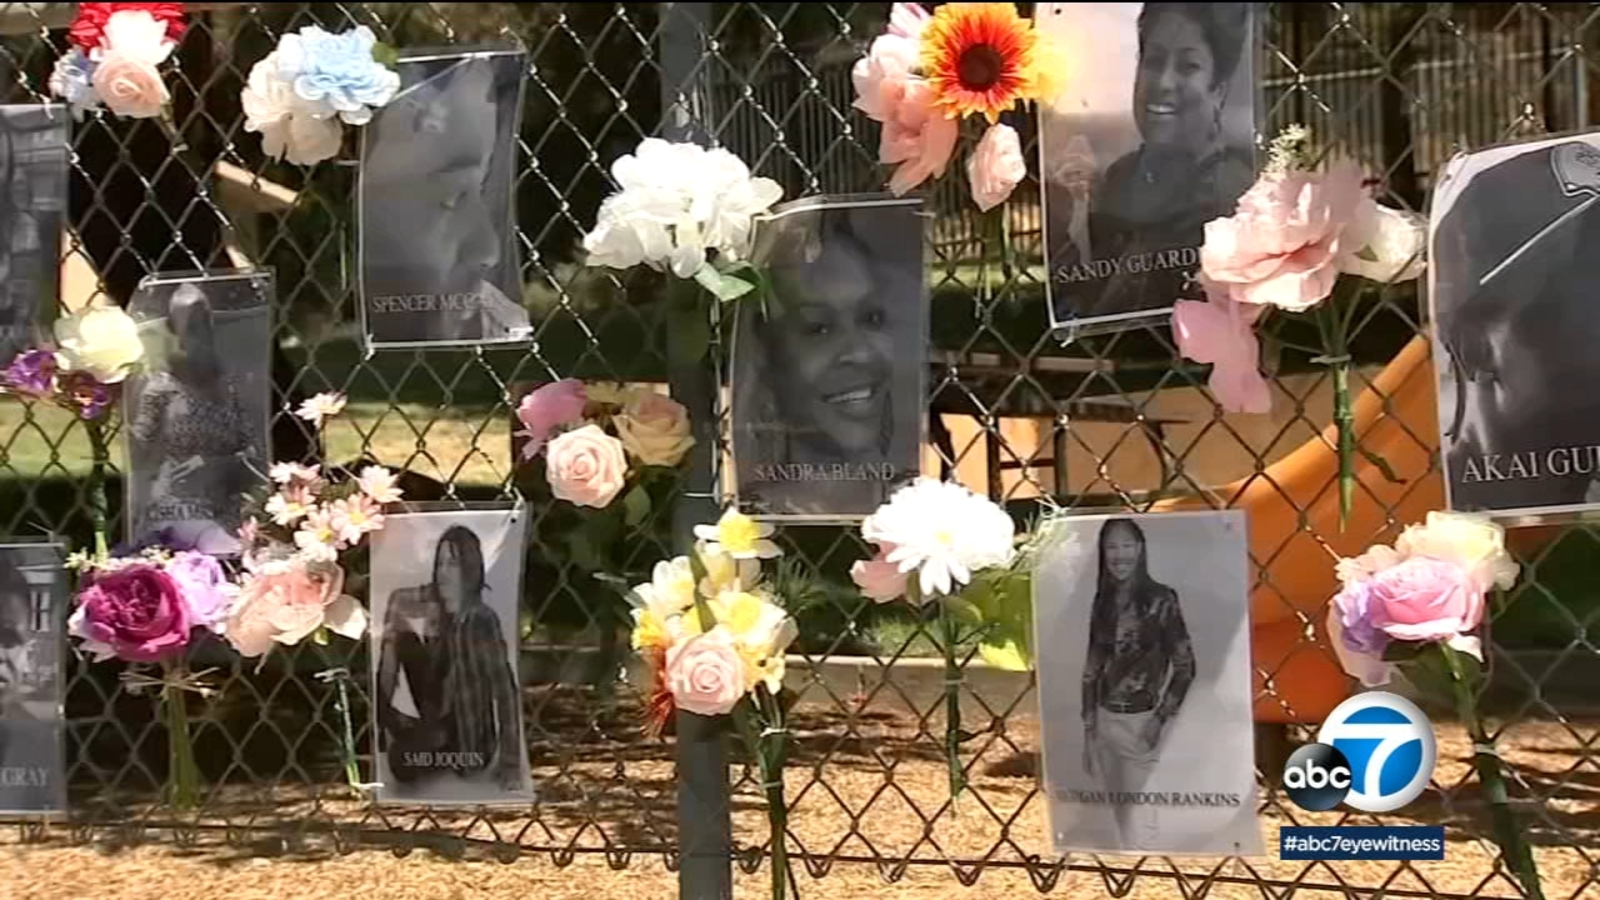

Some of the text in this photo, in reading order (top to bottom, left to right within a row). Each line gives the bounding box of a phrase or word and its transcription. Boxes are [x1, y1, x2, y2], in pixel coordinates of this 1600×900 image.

[1057, 246, 1203, 284] SANDY GUARD
[372, 295, 437, 313] SPENCER
[753, 461, 896, 481] SANDRA BLAND
[1461, 445, 1600, 483] AKAI GU
[402, 751, 485, 770] SAID JOQUIN
[1, 766, 50, 788] GRAY
[1109, 790, 1168, 805] LONDON
[1170, 792, 1241, 808] RANKINS
